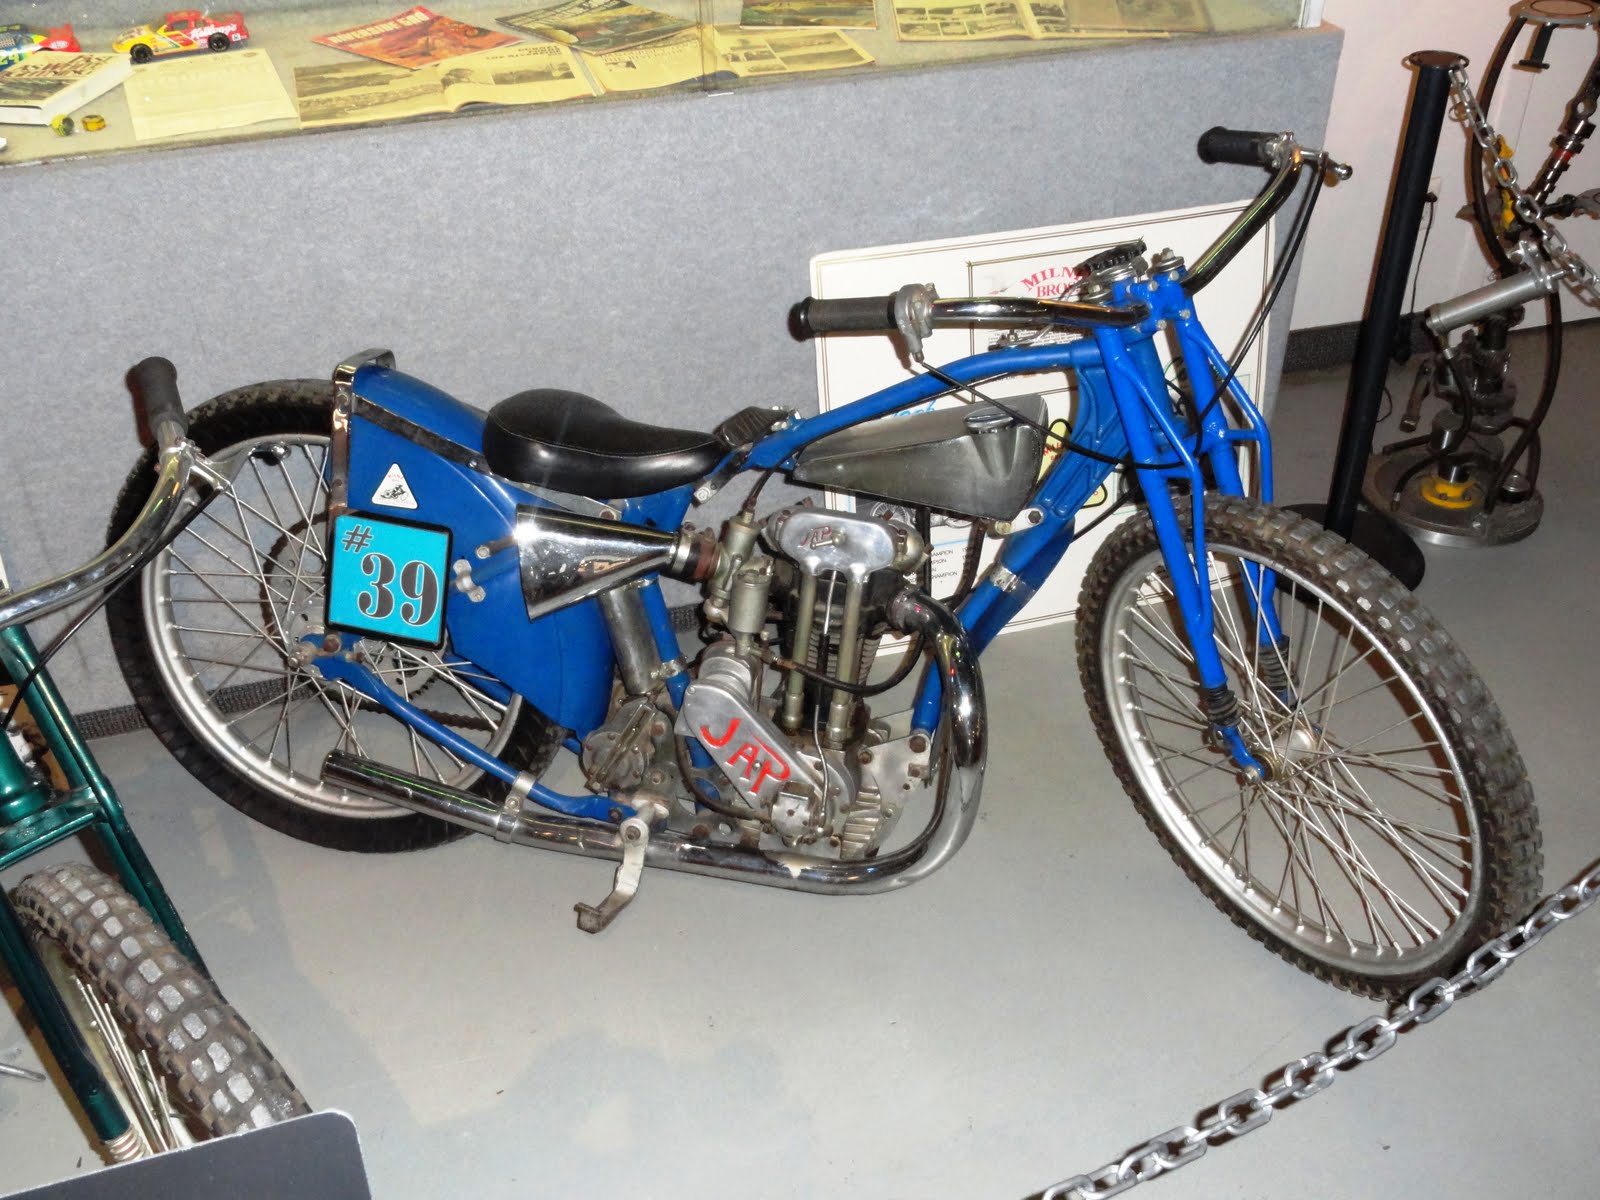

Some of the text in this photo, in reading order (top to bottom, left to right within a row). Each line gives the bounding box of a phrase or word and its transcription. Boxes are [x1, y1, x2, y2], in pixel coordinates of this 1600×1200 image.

[327, 11, 430, 44] RIVERSIDE 500
[357, 552, 439, 627] 39
[700, 718, 791, 794] JAP
